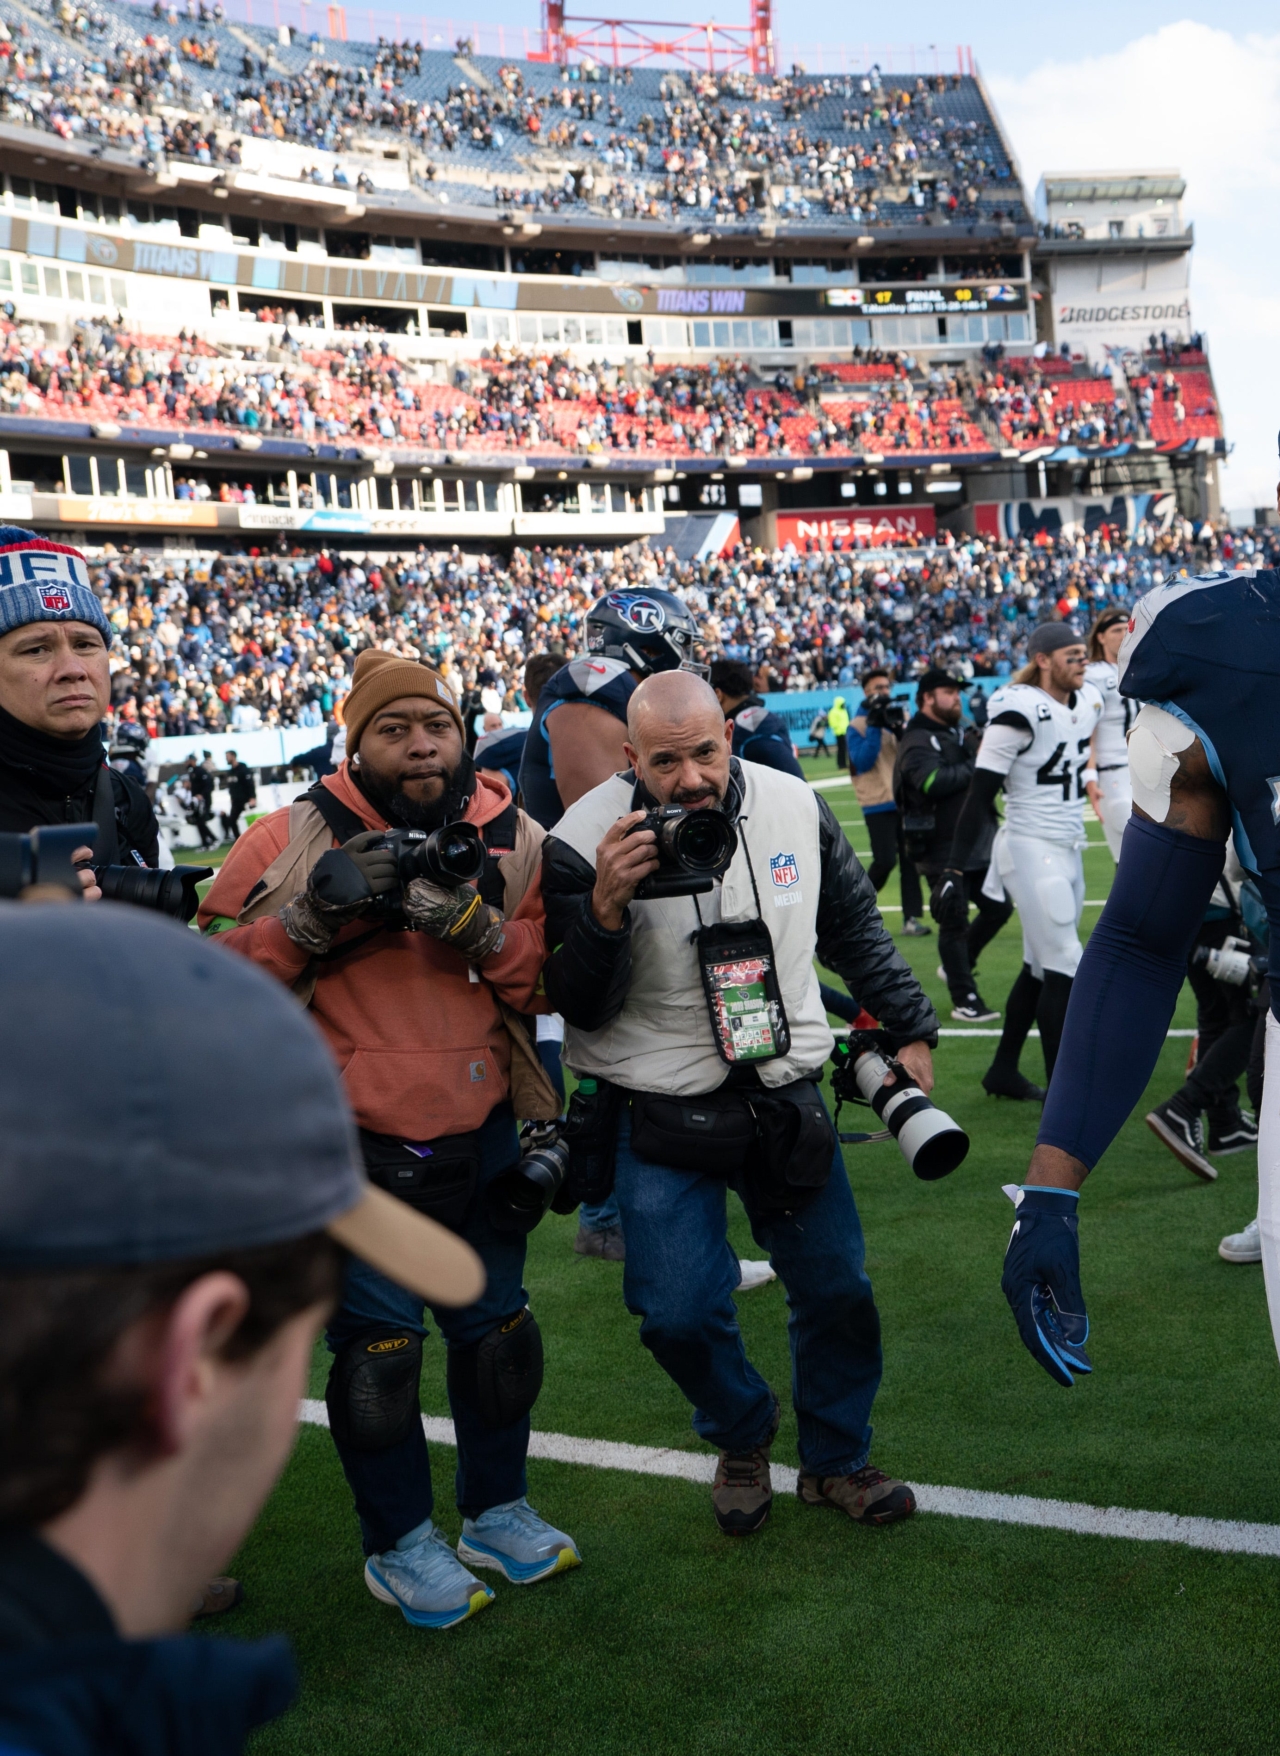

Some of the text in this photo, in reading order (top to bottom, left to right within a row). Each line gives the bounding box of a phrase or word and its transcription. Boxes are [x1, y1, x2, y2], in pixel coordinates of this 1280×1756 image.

[656, 289, 746, 313] TITANS WIN
[1059, 304, 1187, 324] BRIDGESTONE
[797, 516, 917, 538] NISSAN
[44, 596, 69, 610] NFL
[774, 866, 797, 885] NFL
[774, 890, 803, 908] MEDI
[379, 1340, 401, 1351] AWP
